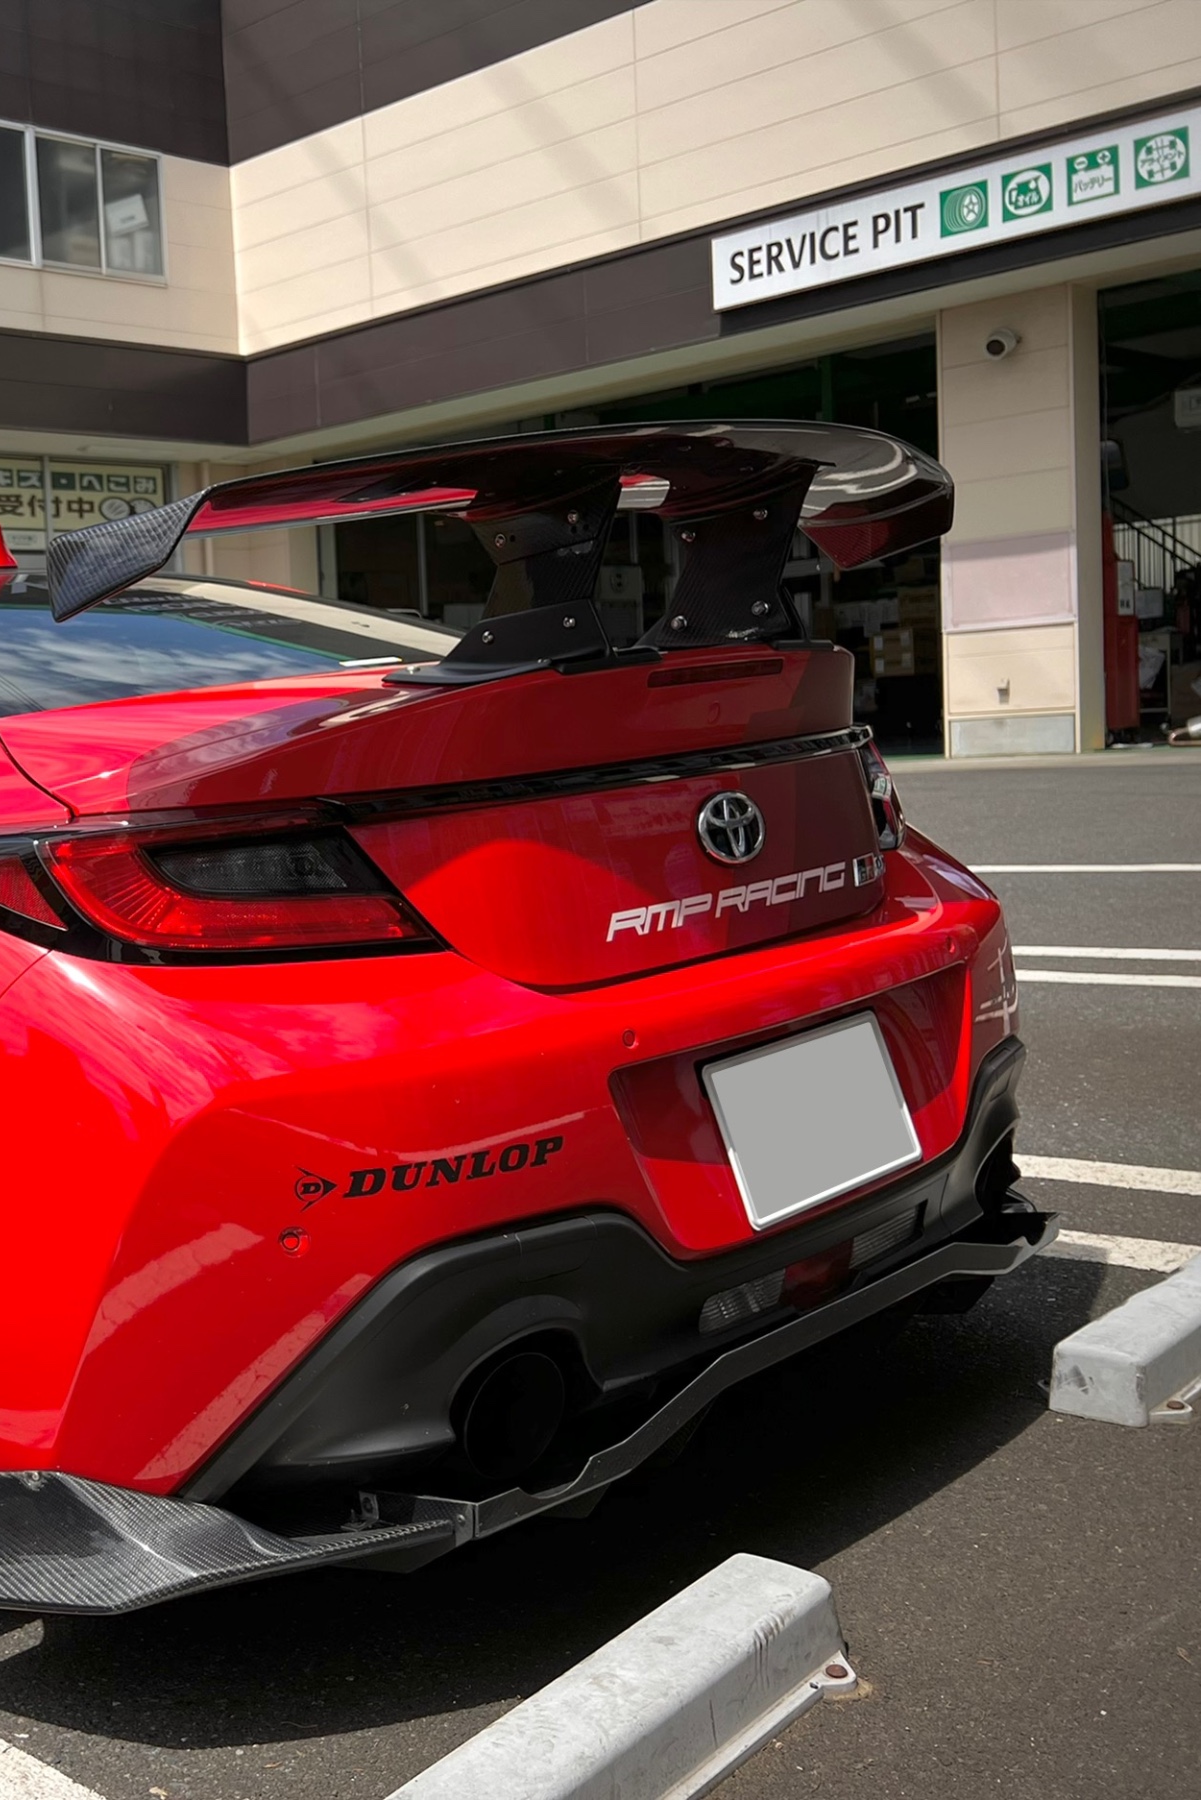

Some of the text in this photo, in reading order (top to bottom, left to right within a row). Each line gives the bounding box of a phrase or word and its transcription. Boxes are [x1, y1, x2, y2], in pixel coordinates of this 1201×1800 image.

[1139, 150, 1184, 169] アライメント
[1016, 191, 1041, 207] オイル
[1073, 174, 1114, 194] バッテリー
[728, 202, 926, 287] SERVICE PIT
[605, 893, 714, 943] RMP
[714, 861, 847, 919] RACING
[342, 1135, 565, 1199] DUNLOP
